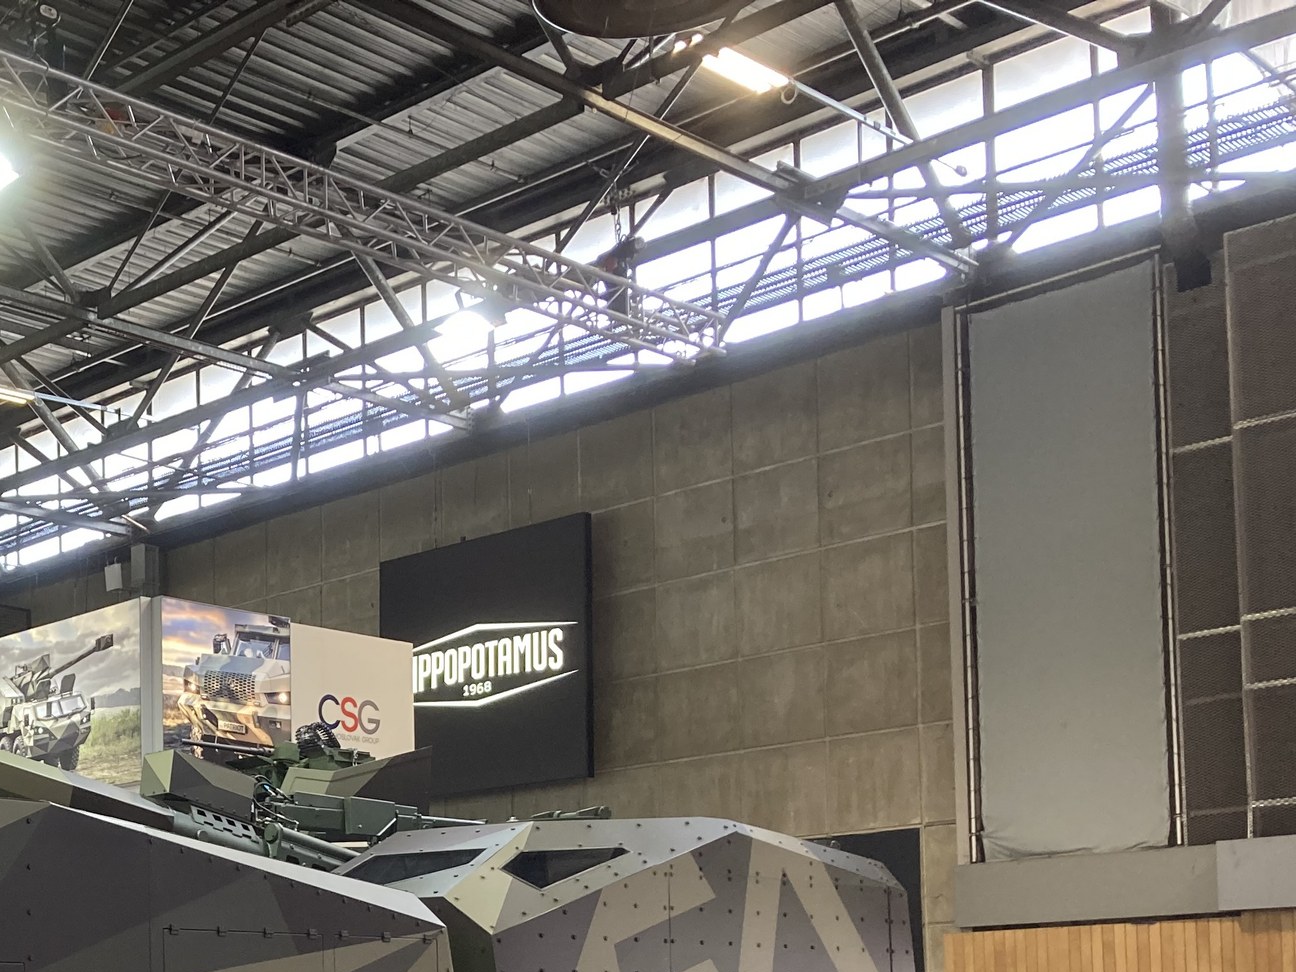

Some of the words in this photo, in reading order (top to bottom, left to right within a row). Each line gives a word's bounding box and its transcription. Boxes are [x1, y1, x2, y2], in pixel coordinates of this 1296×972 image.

[412, 627, 564, 694] IPPOPOTAMUS
[463, 681, 492, 697] 1968
[318, 694, 381, 735] CSG
